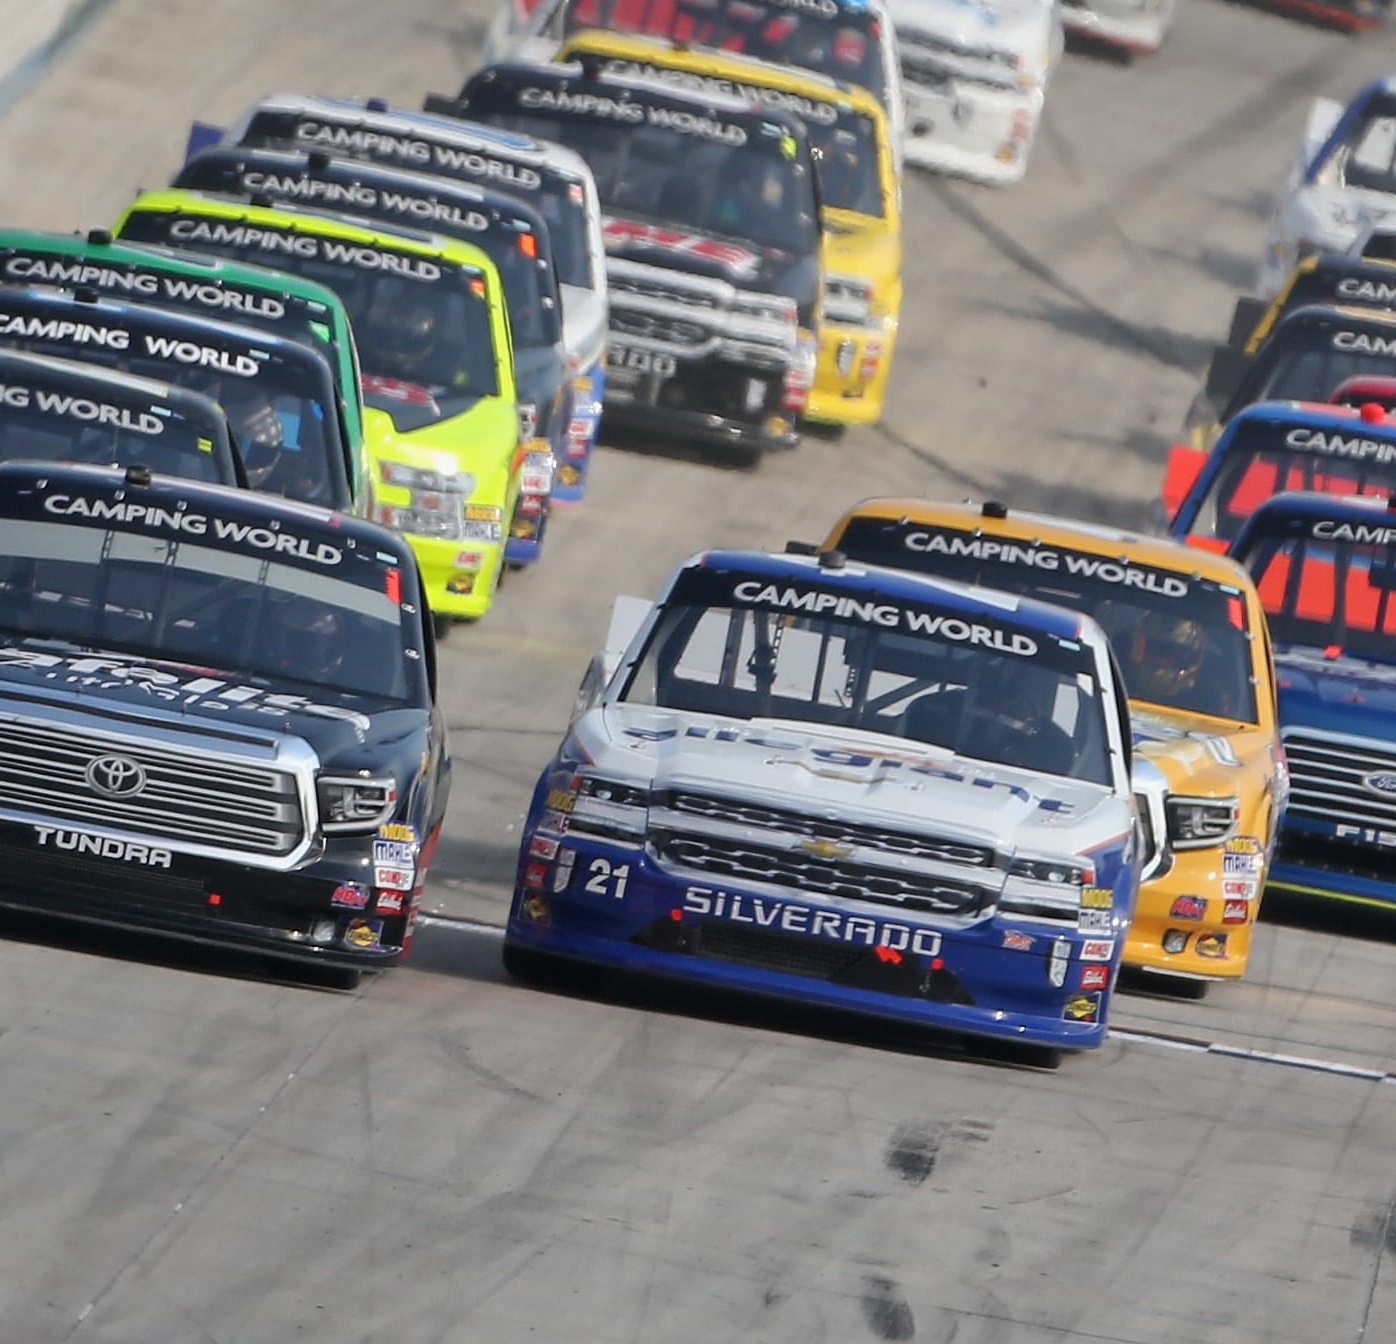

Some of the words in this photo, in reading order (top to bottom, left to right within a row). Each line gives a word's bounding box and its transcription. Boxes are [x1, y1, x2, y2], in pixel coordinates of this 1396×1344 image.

[519, 87, 645, 124] CAMPING
[648, 107, 748, 147] WORLD
[298, 122, 431, 160] CAMPING
[435, 148, 542, 190] WORLD
[244, 172, 376, 205] CAMPING
[381, 191, 490, 232] WORLD
[170, 219, 318, 258] CAMPING
[324, 241, 442, 281] WORLD
[6, 257, 158, 294] CAMPING
[163, 278, 285, 320] WORLD
[145, 335, 260, 378] WORLD
[36, 390, 165, 436] WORLD
[44, 494, 207, 535] CAMPING
[213, 519, 343, 566] WORLD
[905, 531, 1059, 571] CAMPING
[1064, 554, 1189, 599] WORLD
[733, 580, 900, 628] CAMPING
[904, 611, 1039, 657] WORLD
[34, 825, 172, 869] TUNDRA
[585, 858, 630, 899] 21
[683, 886, 943, 957] SILVERADO
